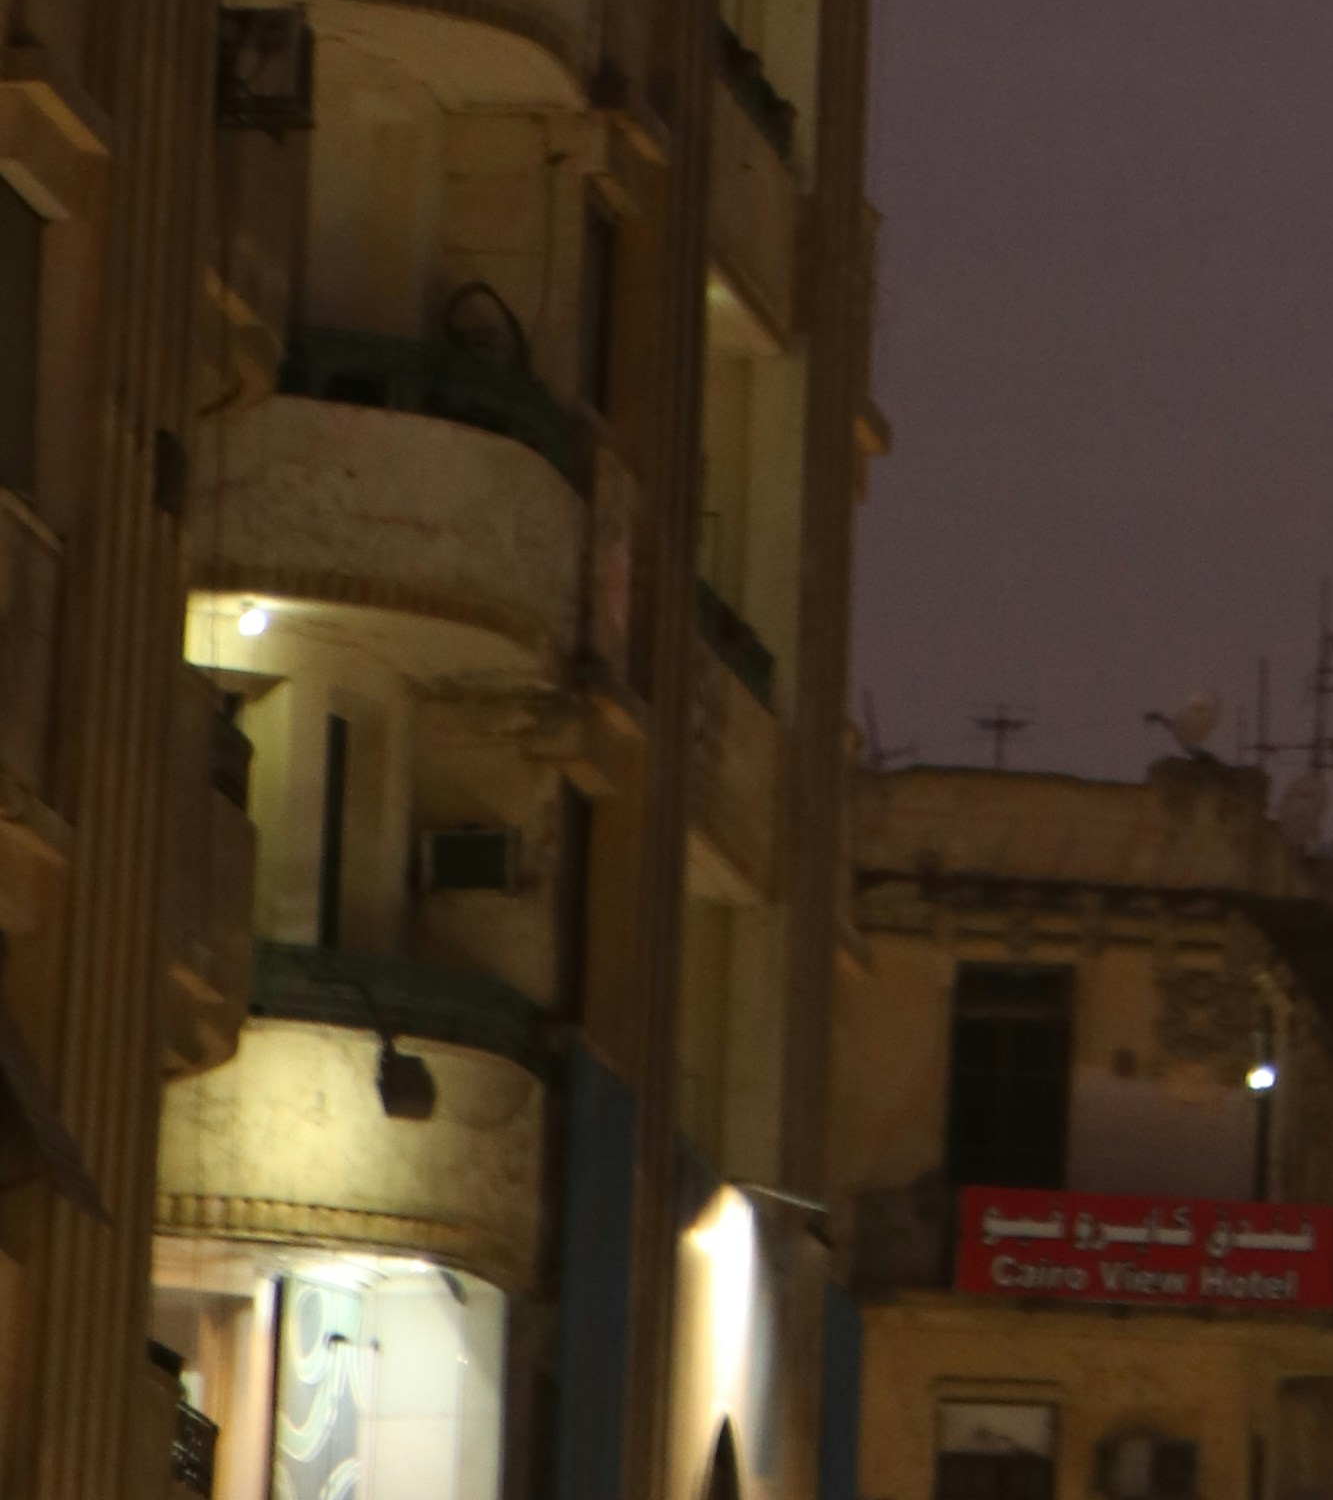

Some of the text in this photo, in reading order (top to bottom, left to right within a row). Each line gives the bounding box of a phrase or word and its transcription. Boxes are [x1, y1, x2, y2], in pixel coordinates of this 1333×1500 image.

[980, 1202, 1316, 1258] فندق كايرو فيو
[990, 1255, 1299, 1298] Cairo View Hotel
